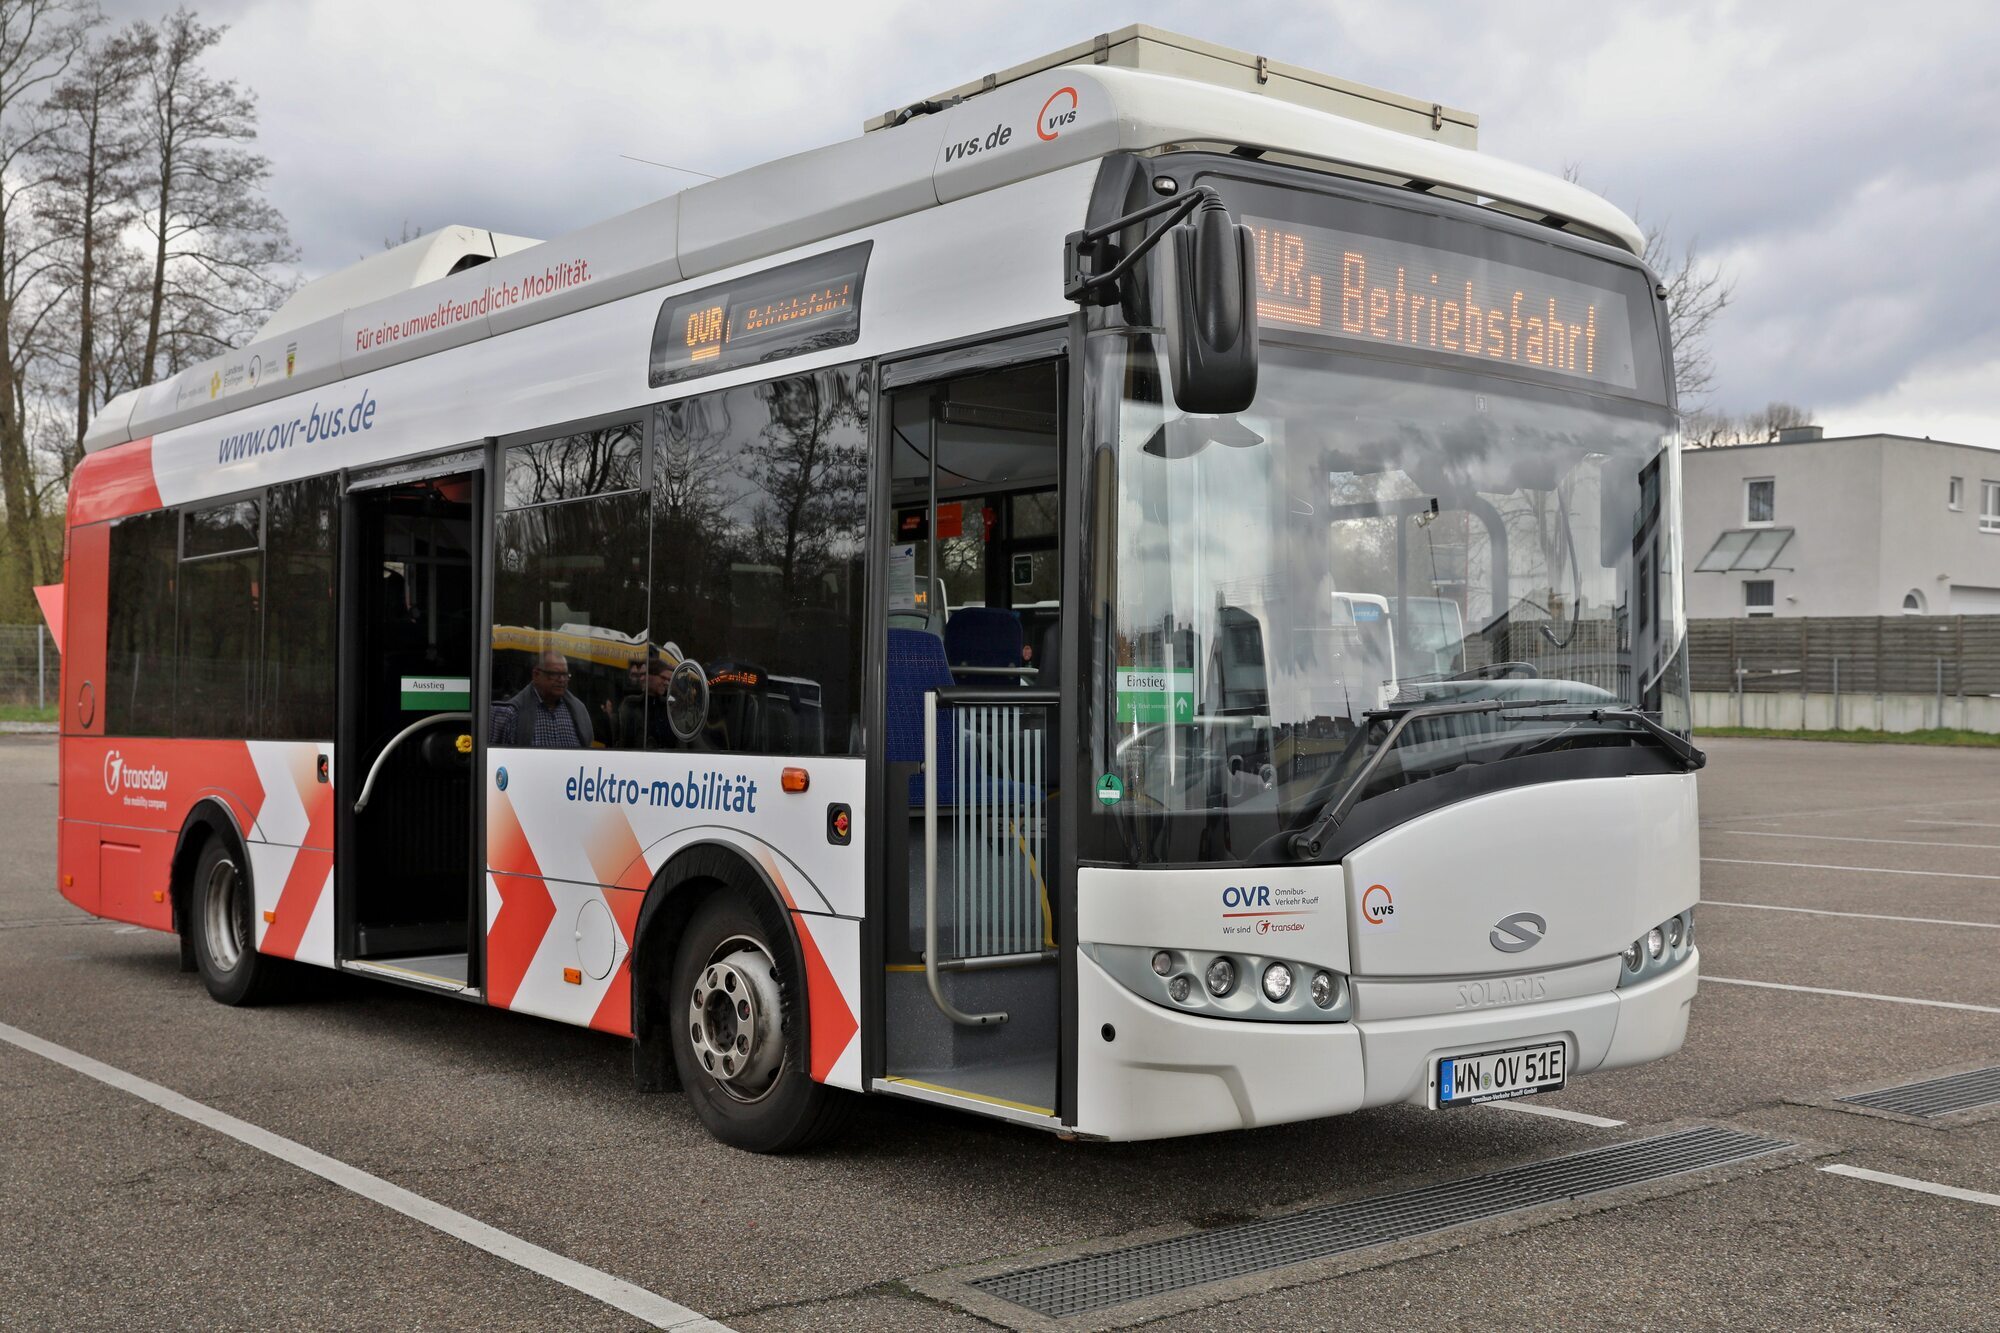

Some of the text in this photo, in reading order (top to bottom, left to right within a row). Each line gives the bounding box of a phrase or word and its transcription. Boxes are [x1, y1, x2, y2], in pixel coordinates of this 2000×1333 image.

[945, 123, 1012, 163] vvs.de
[356, 258, 592, 352] Für eine umweltfreundliche Mobilität.
[1250, 226, 1596, 373] VR Betriebsfahrt
[686, 305, 723, 347] OVR
[218, 388, 377, 465] www.ovr-bus.de
[412, 681, 445, 691] Ausstieg
[1126, 674, 1167, 691] Einstieg
[122, 764, 169, 791] transdev
[565, 766, 758, 814] elektro-mobilität
[1105, 775, 1114, 790] 4
[1222, 885, 1271, 908] OVR
[1274, 888, 1307, 896] Omnibus-
[1274, 896, 1319, 906] Verkehr Ruoff
[1222, 922, 1306, 935] Wir sind transdev
[1455, 976, 1546, 1010] SOLARIS
[1454, 1049, 1562, 1094] WN OV 51E
[1471, 1087, 1538, 1104] Omnibus-Verkehr Ruoff GmbH
